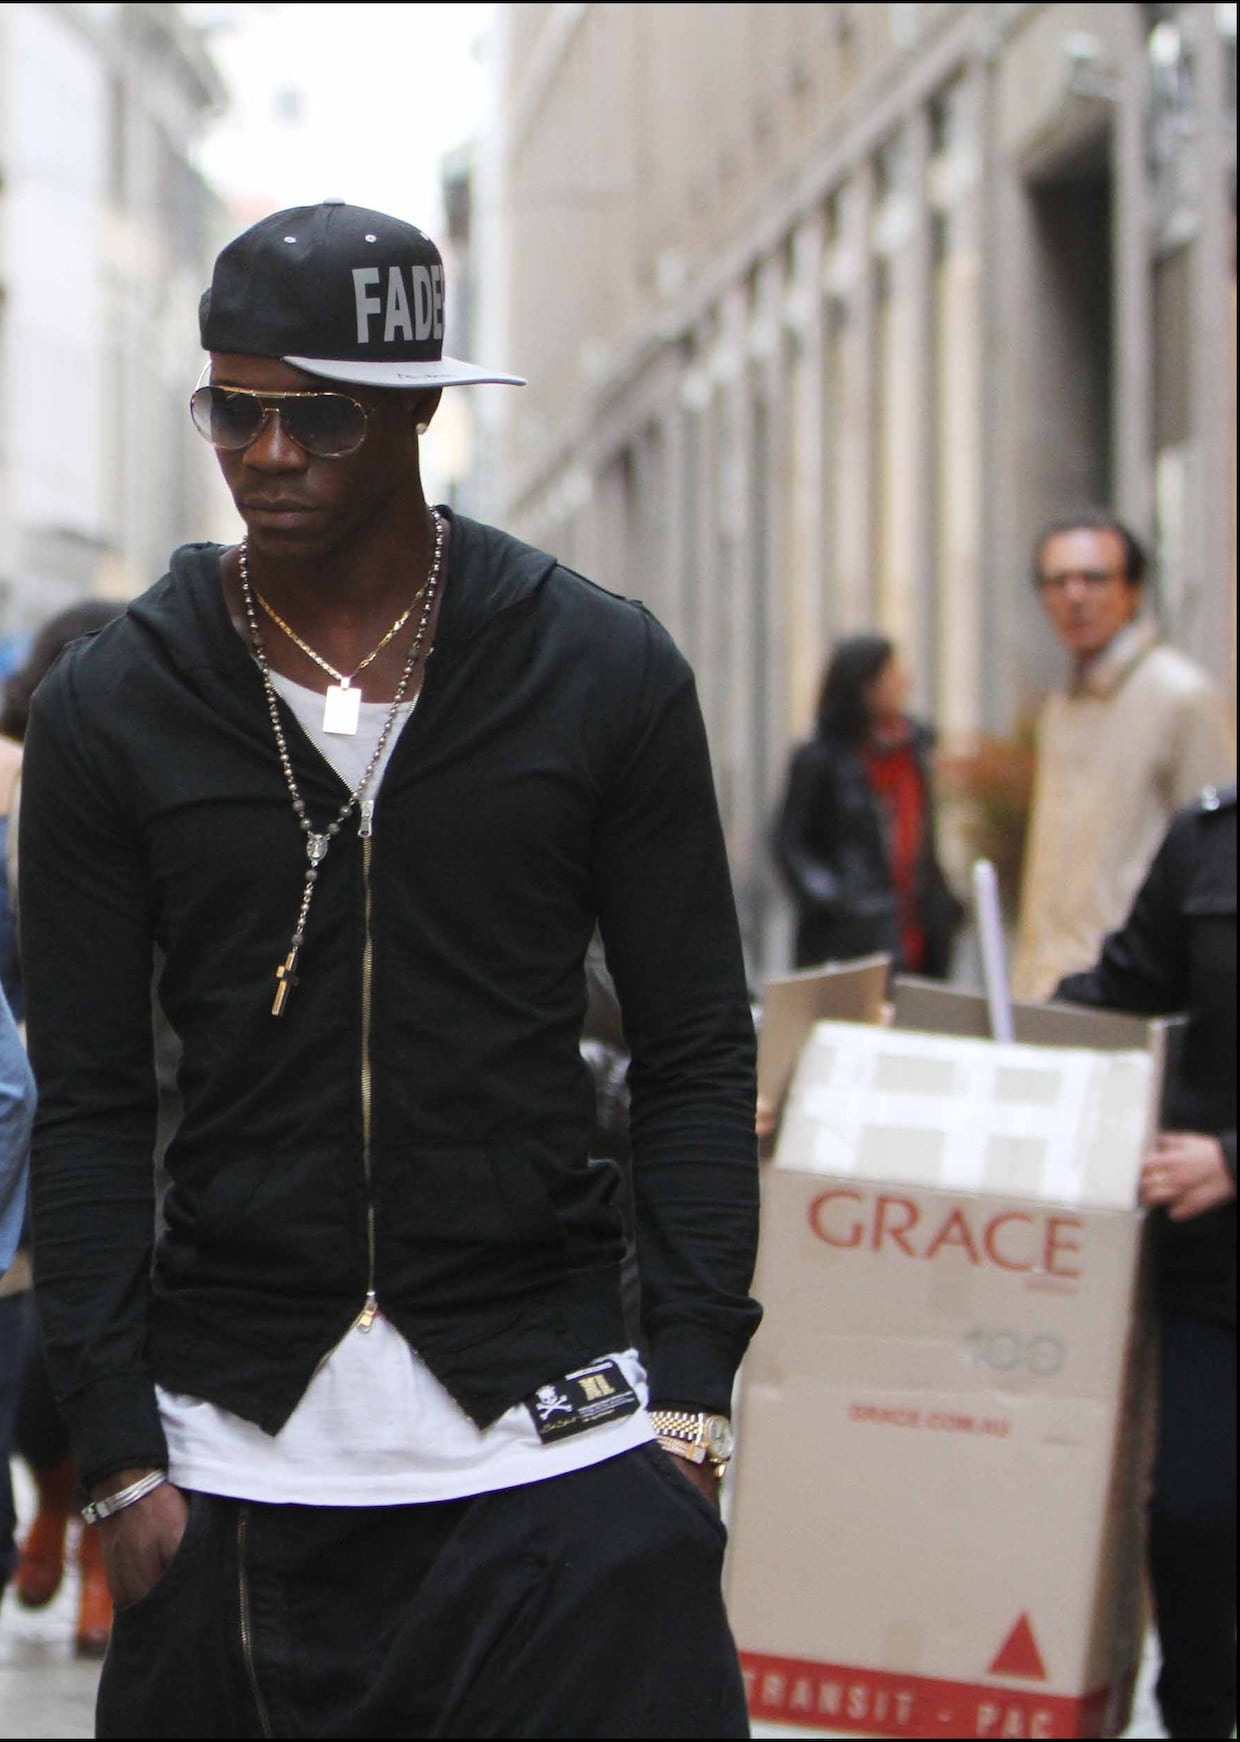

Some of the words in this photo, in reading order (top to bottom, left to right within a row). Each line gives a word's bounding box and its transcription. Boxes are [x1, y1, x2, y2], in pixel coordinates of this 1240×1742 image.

[351, 264, 445, 344] FADE
[807, 1189, 1083, 1278] GRACE
[963, 1327, 1065, 1376] 100
